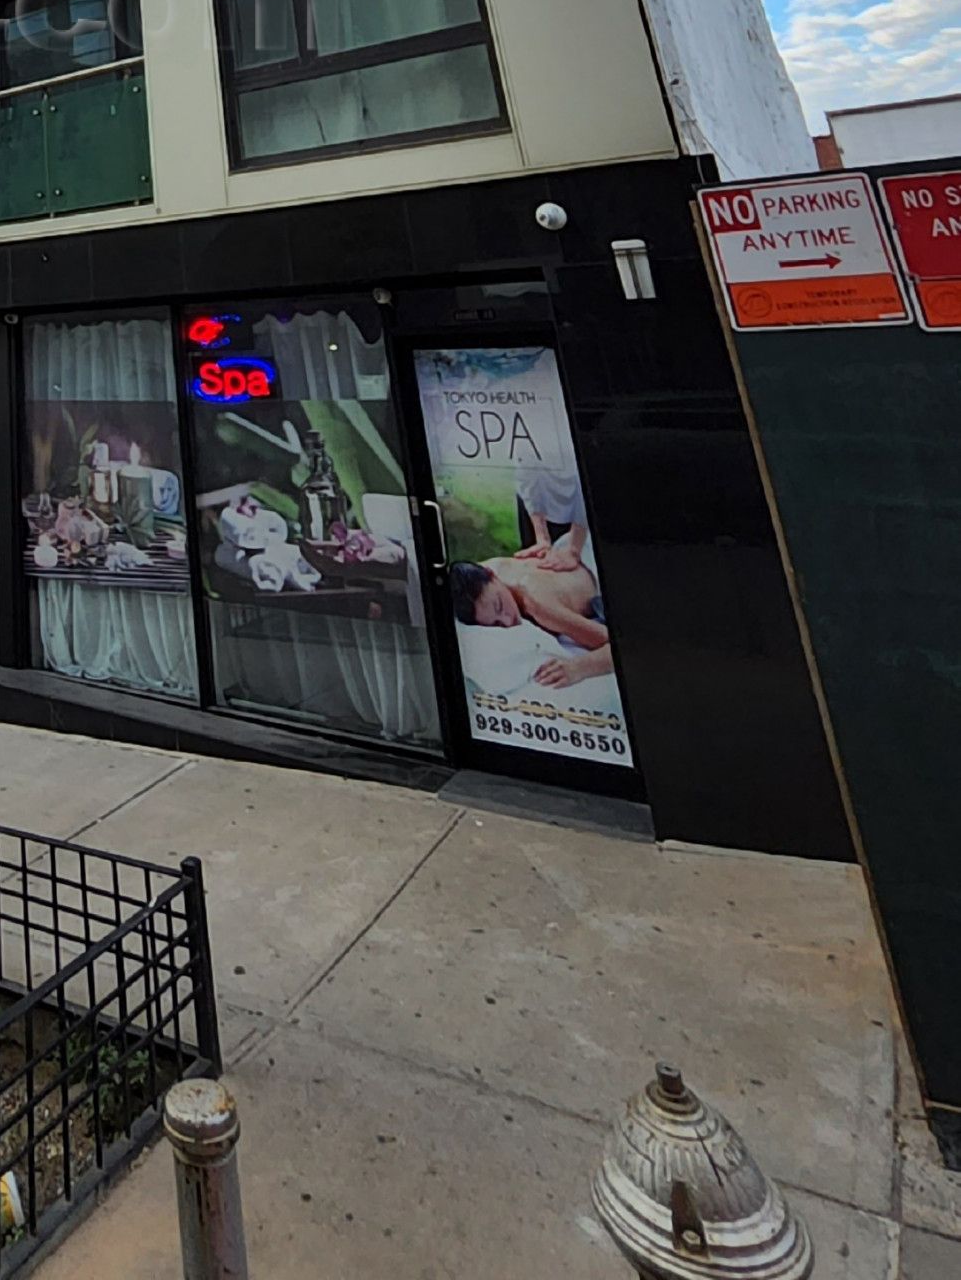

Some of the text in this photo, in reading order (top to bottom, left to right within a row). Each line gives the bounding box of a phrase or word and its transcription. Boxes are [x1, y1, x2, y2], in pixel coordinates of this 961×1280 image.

[708, 190, 861, 227] NO PARKING
[901, 186, 961, 209] NO S
[743, 227, 856, 253] ANYTIME
[199, 363, 270, 399] Spa
[443, 391, 536, 405] TOKYO HEALTH
[455, 410, 542, 461] SPA
[475, 713, 626, 756] 929-300-6550
